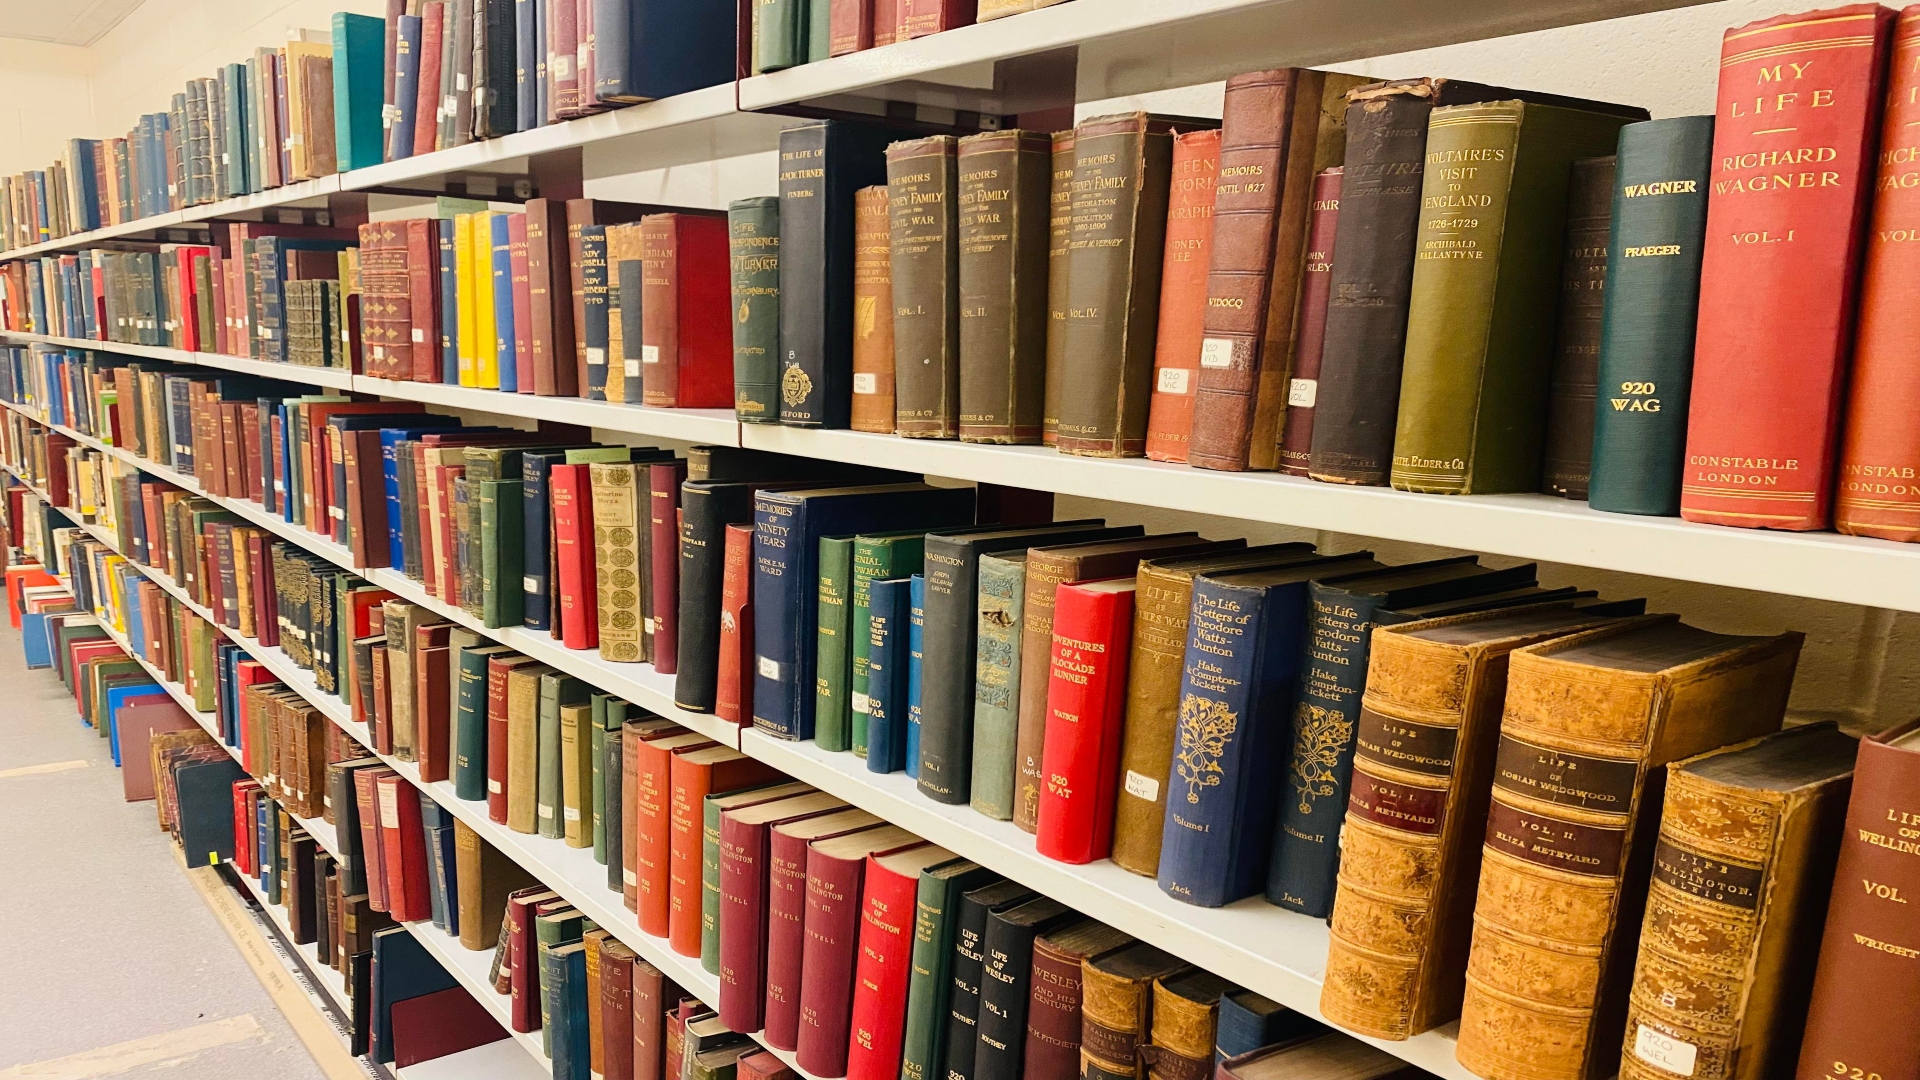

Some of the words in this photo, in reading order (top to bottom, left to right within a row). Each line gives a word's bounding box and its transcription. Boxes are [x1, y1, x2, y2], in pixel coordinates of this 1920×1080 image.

[1757, 62, 1812, 84] MY
[1732, 90, 1835, 118] LIFE
[782, 152, 794, 160] THE
[796, 150, 811, 159] LIFE
[1077, 154, 1115, 167] MEMOIRS
[1427, 148, 1504, 164] VOLTAIRE'S
[1722, 147, 1836, 172] RICHARD
[1221, 166, 1263, 177] MEMOIRS
[1440, 167, 1477, 180] VISIT
[1095, 176, 1127, 189] FAMILY
[1217, 184, 1240, 194] UNTIL
[1245, 183, 1265, 192] 1827
[1624, 180, 1696, 198] WAGNER
[1715, 172, 1840, 196] WAGNER
[787, 190, 814, 199] FINBERG
[911, 192, 943, 204] FAMILY
[977, 190, 1009, 202] FAMILY
[1181, 195, 1188, 204] A
[1425, 195, 1491, 208] ENGLAND
[912, 216, 934, 225] WAR
[978, 214, 1000, 223] WAR
[1428, 218, 1478, 229] 1726-1729
[1732, 230, 1781, 244] VOL.
[1788, 230, 1794, 242] I
[1424, 240, 1476, 250] ARCHIBALD
[1625, 245, 1680, 257] PRAEGER
[1173, 252, 1190, 262] LEE
[1420, 251, 1483, 259] BALLANTYNE
[1209, 298, 1242, 309] VIDOCQ
[789, 351, 795, 359] B
[1164, 381, 1177, 389] VIC
[1622, 382, 1655, 395] 920
[1611, 398, 1660, 412] WAG
[1411, 455, 1442, 468] ELDER
[1443, 461, 1451, 469] &
[1690, 456, 1798, 470] CONSTABLE
[1698, 472, 1778, 485] LONDON
[755, 502, 792, 516] MEMORIES
[757, 522, 790, 536] NINETY
[758, 535, 786, 548] YEARS
[859, 548, 872, 556] THE
[925, 552, 964, 567] WASHINGTON
[760, 565, 782, 576] WARD
[1030, 561, 1063, 574] GEORGE
[821, 577, 832, 586] THE
[1146, 586, 1182, 604] LIFE
[1198, 593, 1215, 607] The
[1218, 598, 1240, 612] Life
[1235, 613, 1251, 625] of
[1334, 606, 1357, 618] Life
[1193, 614, 1243, 635] Theodore
[1352, 622, 1369, 632] of
[1197, 628, 1232, 644] Watts-
[1061, 650, 1072, 658] OF
[1074, 652, 1080, 660] A
[1193, 640, 1233, 658] Dunton
[1052, 653, 1095, 674] BLOCKADE
[1198, 660, 1222, 674] Hake
[1054, 668, 1087, 685] RUNNER
[1312, 668, 1337, 682] Hake
[818, 678, 828, 687] 920
[1190, 676, 1226, 693] Rickett
[869, 699, 881, 708] 920
[1054, 709, 1078, 723] WATSON
[1382, 724, 1416, 738] LIFE
[1027, 756, 1034, 766] B
[1538, 756, 1577, 770] LIFE
[1022, 767, 1042, 779] WAS
[1128, 773, 1143, 785] 920
[1502, 769, 1536, 788] JOSIAH
[1051, 774, 1068, 787] 920
[1048, 782, 1072, 798] WAT
[1128, 785, 1147, 800] WAT
[1173, 814, 1203, 832] Volume
[1375, 807, 1435, 825] METEYARD
[1284, 825, 1312, 841] Volume
[1521, 820, 1556, 835] VOL.
[1564, 832, 1577, 841] II.
[723, 840, 734, 852] LIFE
[736, 845, 744, 854] OF
[1497, 831, 1525, 848] ELIZA
[1532, 844, 1600, 865] METEYARD
[787, 861, 797, 869] OF
[1680, 854, 1728, 875] LIFE
[810, 875, 822, 887] LIFE
[824, 882, 835, 890] OF
[1658, 859, 1753, 896] WELLINGTON.
[1170, 882, 1191, 896] Jack
[1862, 880, 1906, 903] VOL.
[871, 898, 888, 912] DUKE
[1282, 892, 1304, 906] Jack
[822, 904, 832, 914] III.
[874, 909, 882, 918] OF
[962, 929, 978, 942] LIFE
[964, 940, 974, 948] OF
[1853, 934, 1920, 958] WRIGHT
[864, 946, 876, 959] VOL.
[956, 944, 984, 962] WESLEY
[991, 949, 1008, 962] LIFE
[723, 966, 734, 976] 920
[993, 960, 1004, 970] OF
[722, 973, 737, 985] WEL
[985, 965, 1015, 984] WESLEY
[1034, 965, 1082, 990] WESLEY
[771, 984, 782, 994] 920
[955, 977, 971, 993] VOL.
[1035, 985, 1053, 998] AND
[1057, 993, 1075, 1003] HIS
[1662, 992, 1676, 1008] B
[985, 1000, 1000, 1015] VOL.
[1002, 1010, 1007, 1018] 1
[1034, 993, 1075, 1012] CENTURY
[804, 1007, 817, 1017] 920
[952, 1010, 976, 1026] SOUTHEY
[858, 1028, 871, 1040] 920
[1643, 1031, 1673, 1051] 920
[857, 1035, 873, 1050] WEL
[981, 1034, 1006, 1050] SOUTHEY
[1642, 1045, 1675, 1065] WEL
